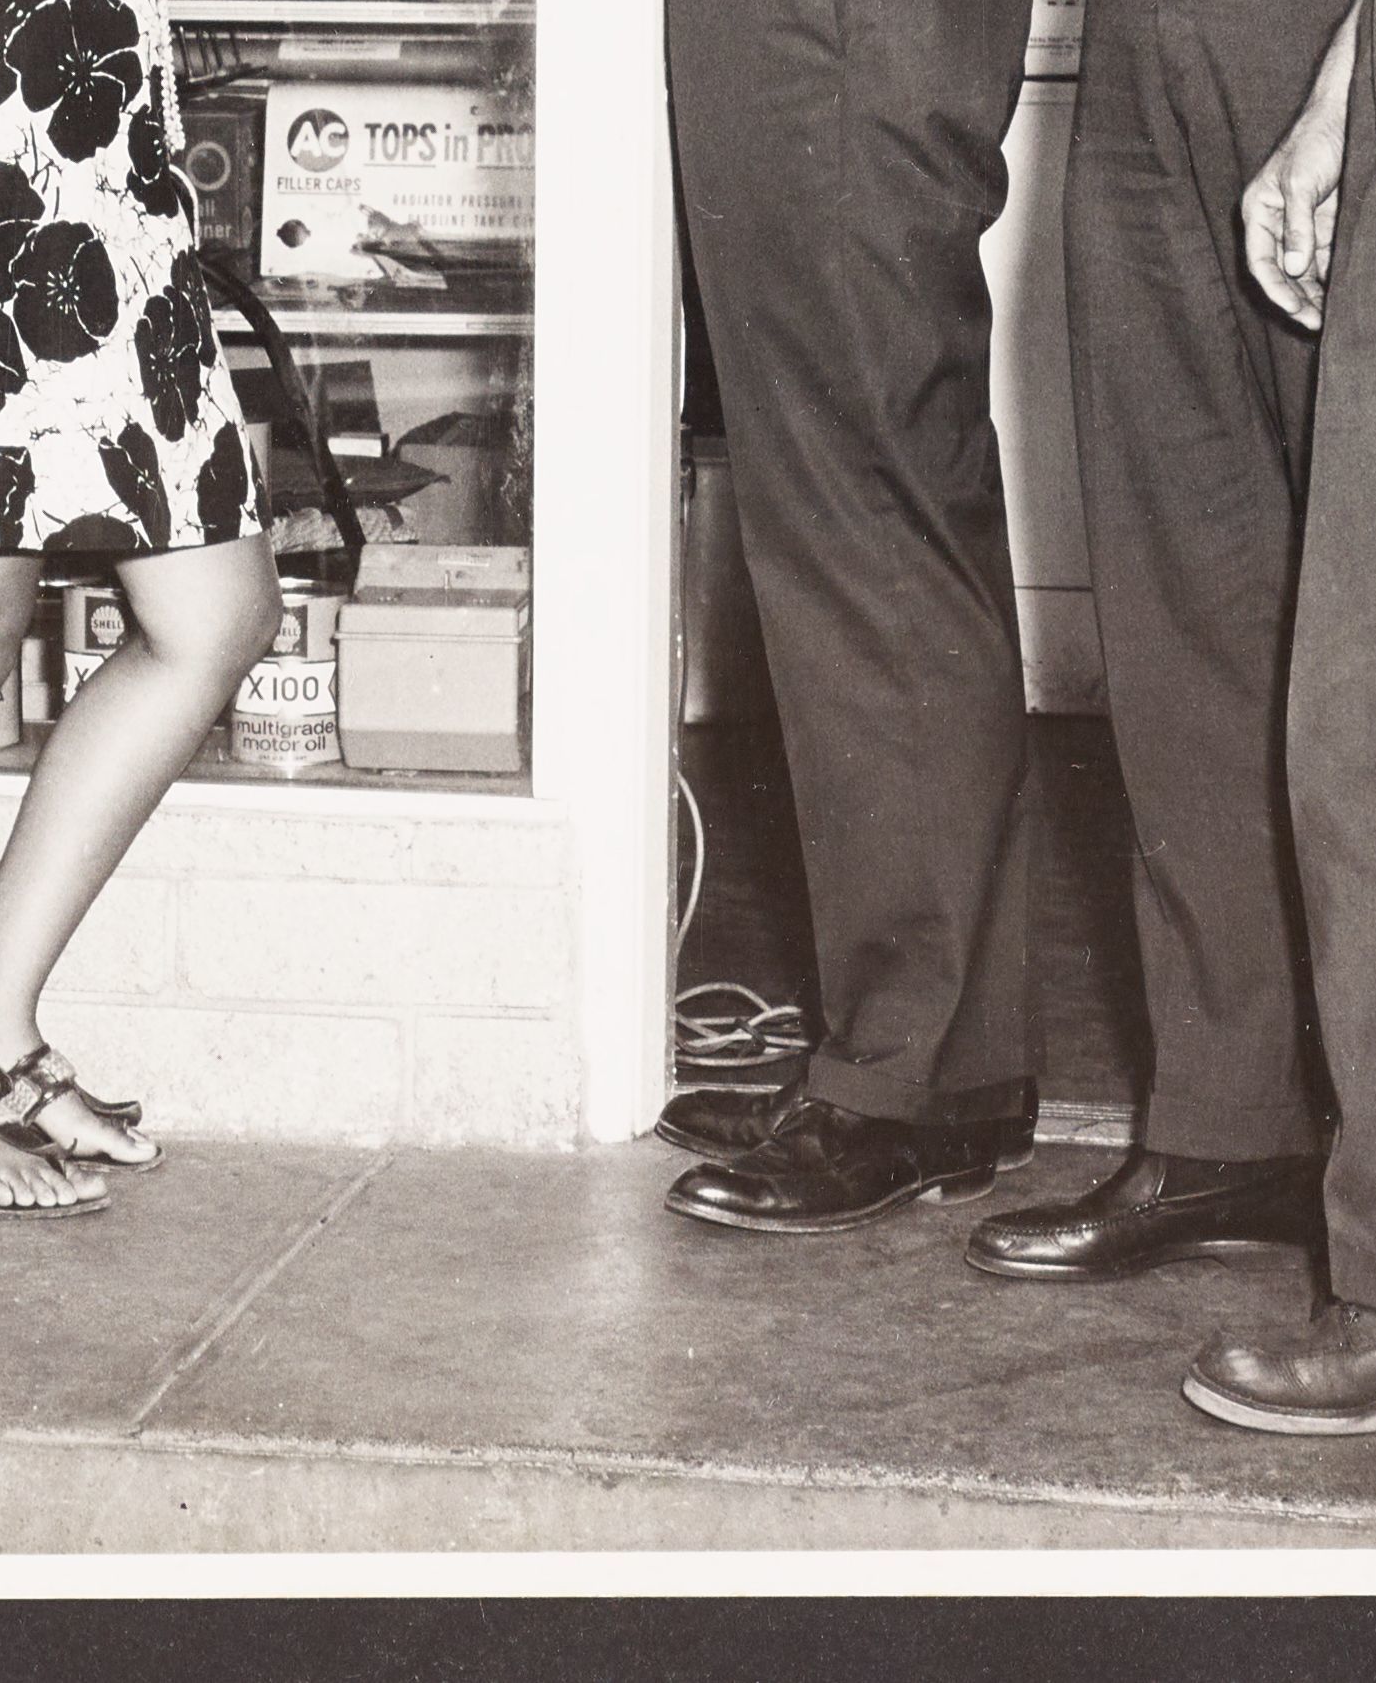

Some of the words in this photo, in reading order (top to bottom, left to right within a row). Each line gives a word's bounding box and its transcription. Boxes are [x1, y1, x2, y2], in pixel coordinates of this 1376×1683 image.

[290, 121, 347, 158] AC
[364, 123, 436, 162] TOPS
[444, 124, 469, 162] in
[277, 177, 321, 191] FILLER
[326, 178, 361, 191] CAPS
[393, 194, 452, 207] RADIATOR
[93, 619, 123, 630] SHELL
[247, 676, 319, 702] X100
[237, 720, 335, 738] multigrade
[243, 736, 299, 752] motor
[305, 736, 326, 751] oil
